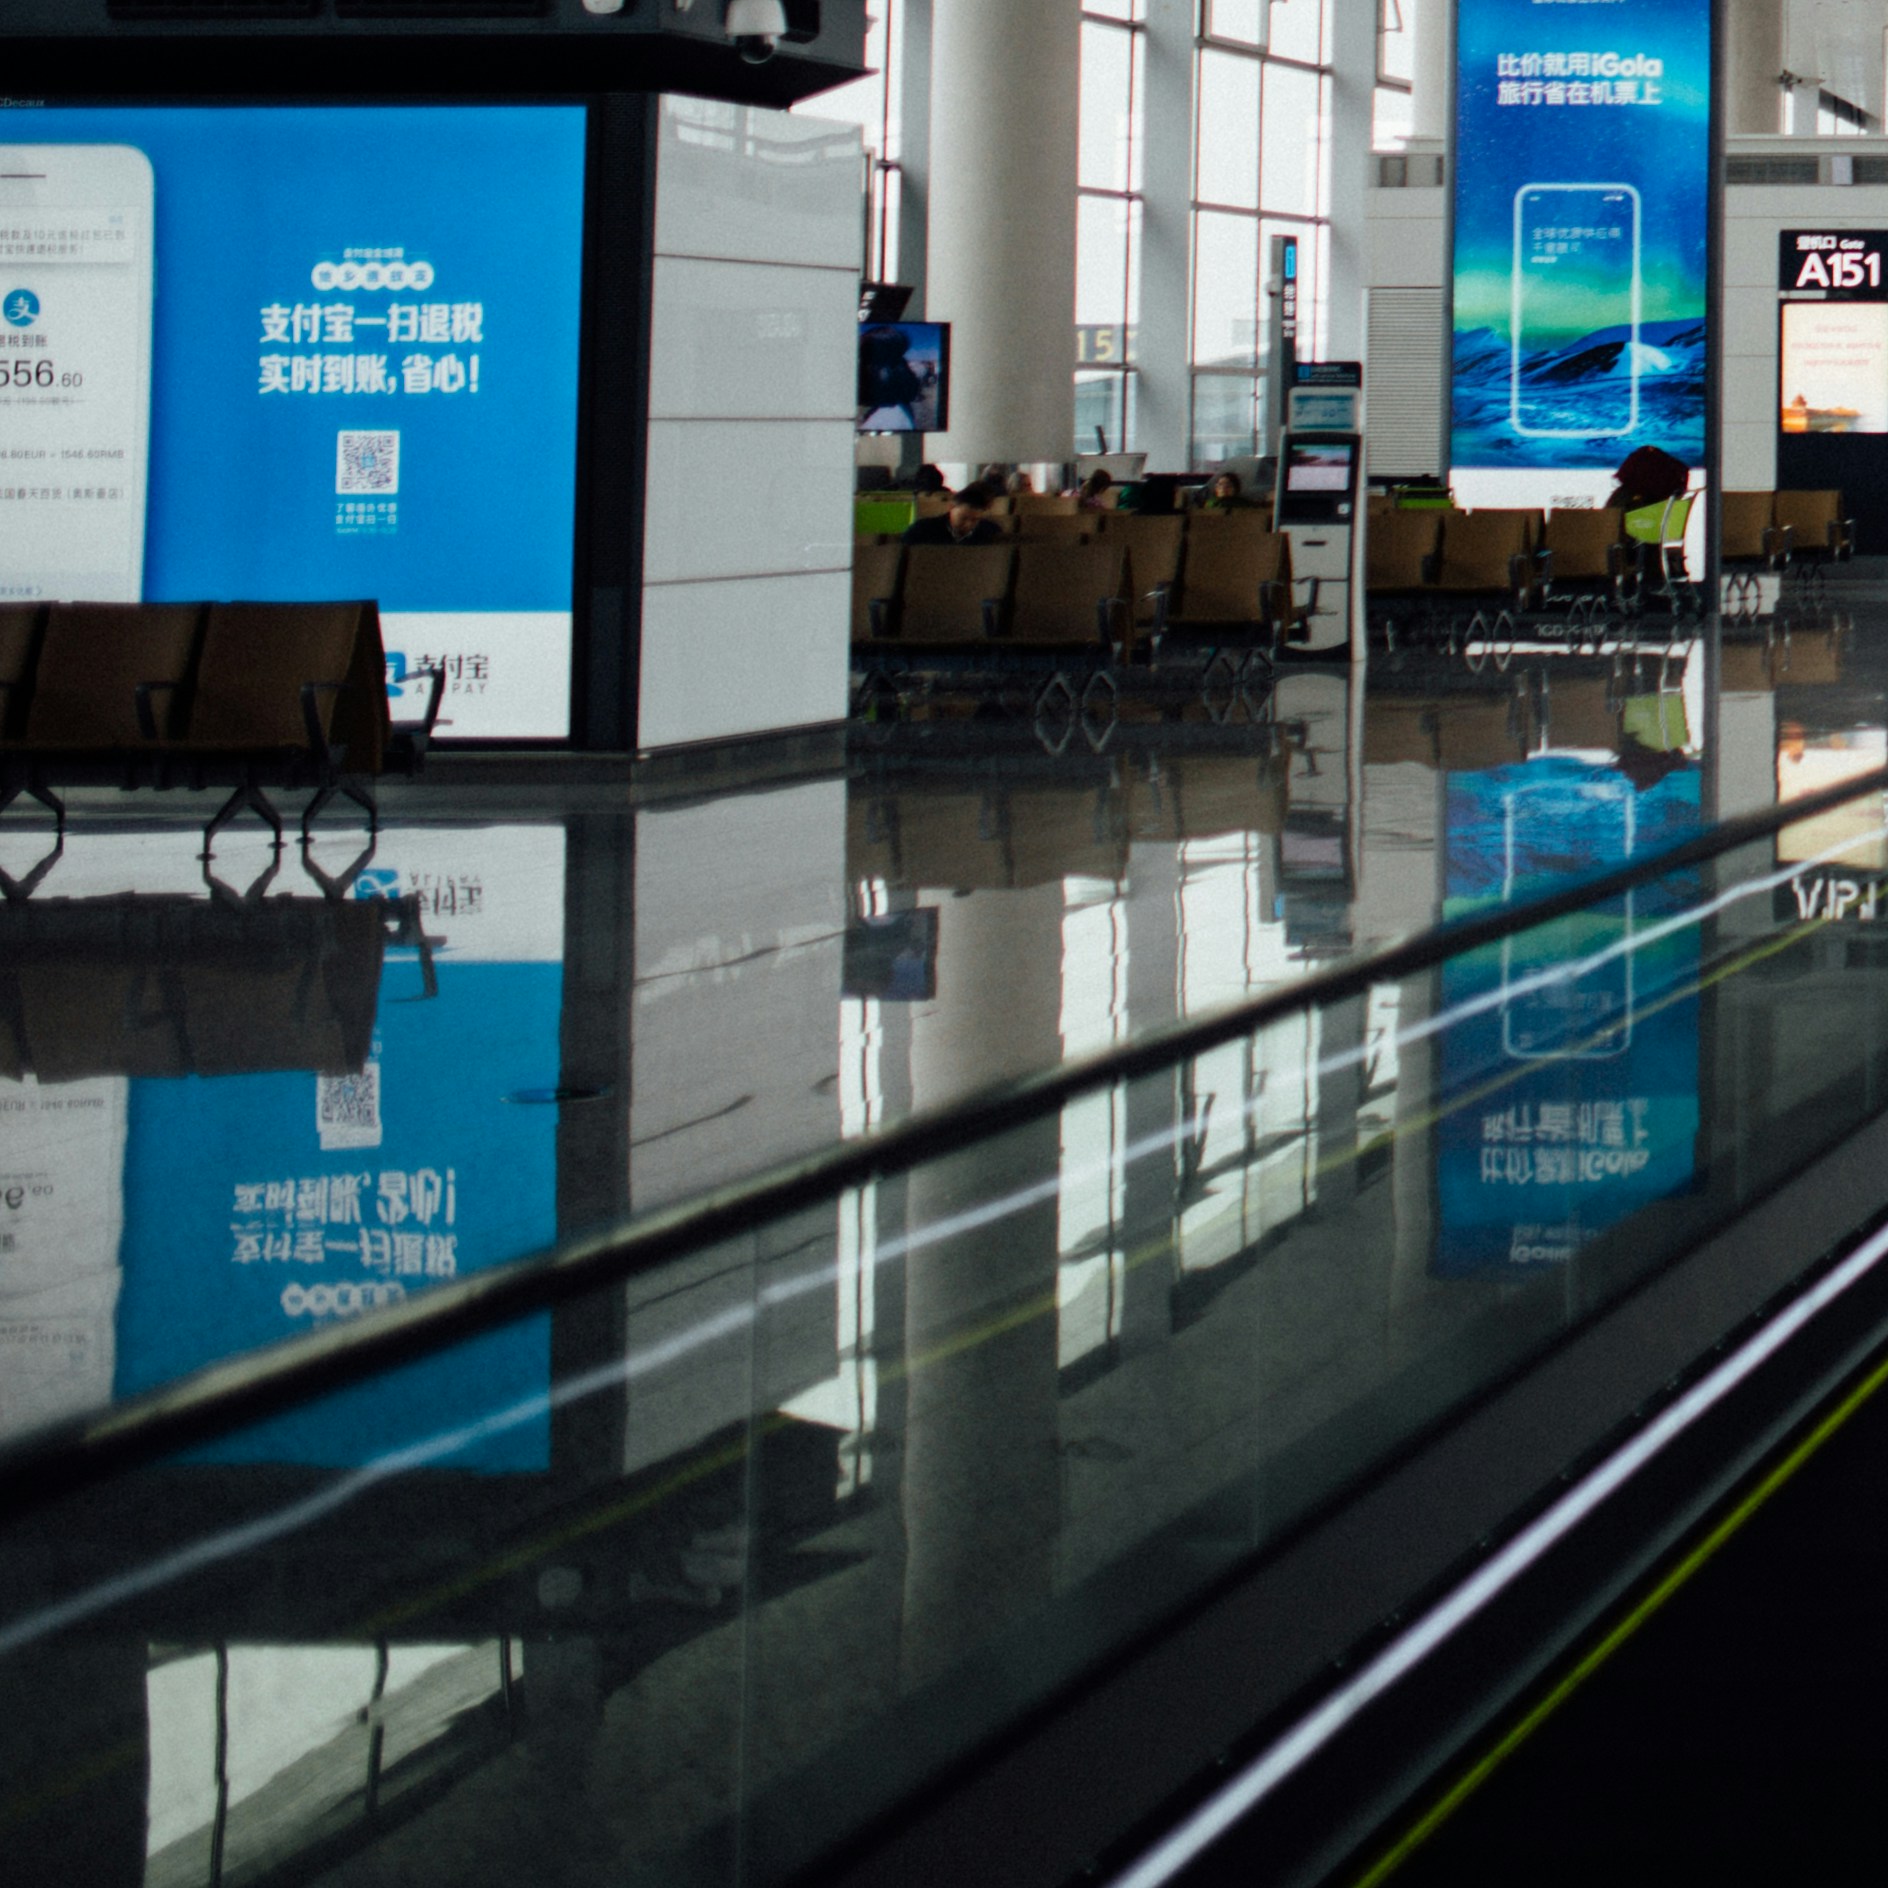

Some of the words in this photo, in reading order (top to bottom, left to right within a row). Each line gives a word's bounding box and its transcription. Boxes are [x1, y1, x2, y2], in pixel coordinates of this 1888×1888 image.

[1497, 52, 1663, 77] 比价就用iGola
[1497, 80, 1663, 105] 旅行省在机票上
[1796, 252, 1881, 287] A151
[260, 303, 483, 343] 支付宝一扫退税
